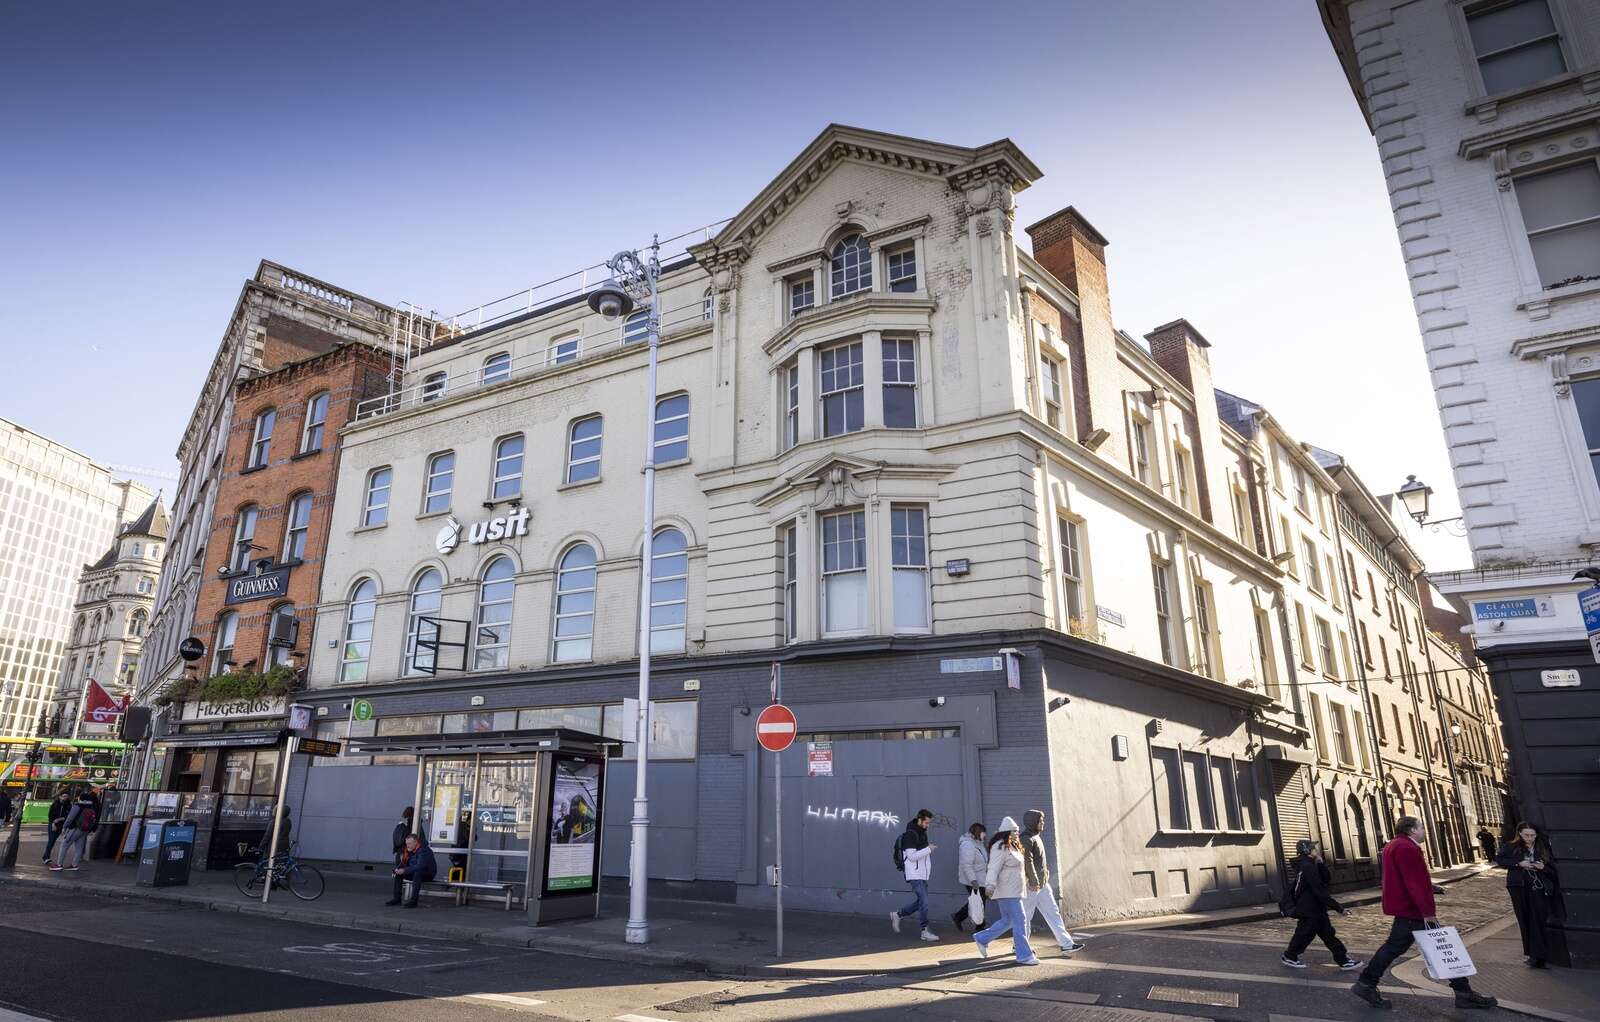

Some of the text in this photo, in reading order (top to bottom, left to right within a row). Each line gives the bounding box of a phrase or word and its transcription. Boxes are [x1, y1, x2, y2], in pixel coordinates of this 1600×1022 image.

[468, 507, 530, 545] usit
[233, 576, 280, 598] GUINNESS
[1478, 609, 1537, 620] ASTON QUAY
[1428, 930, 1449, 938] TOOLS
